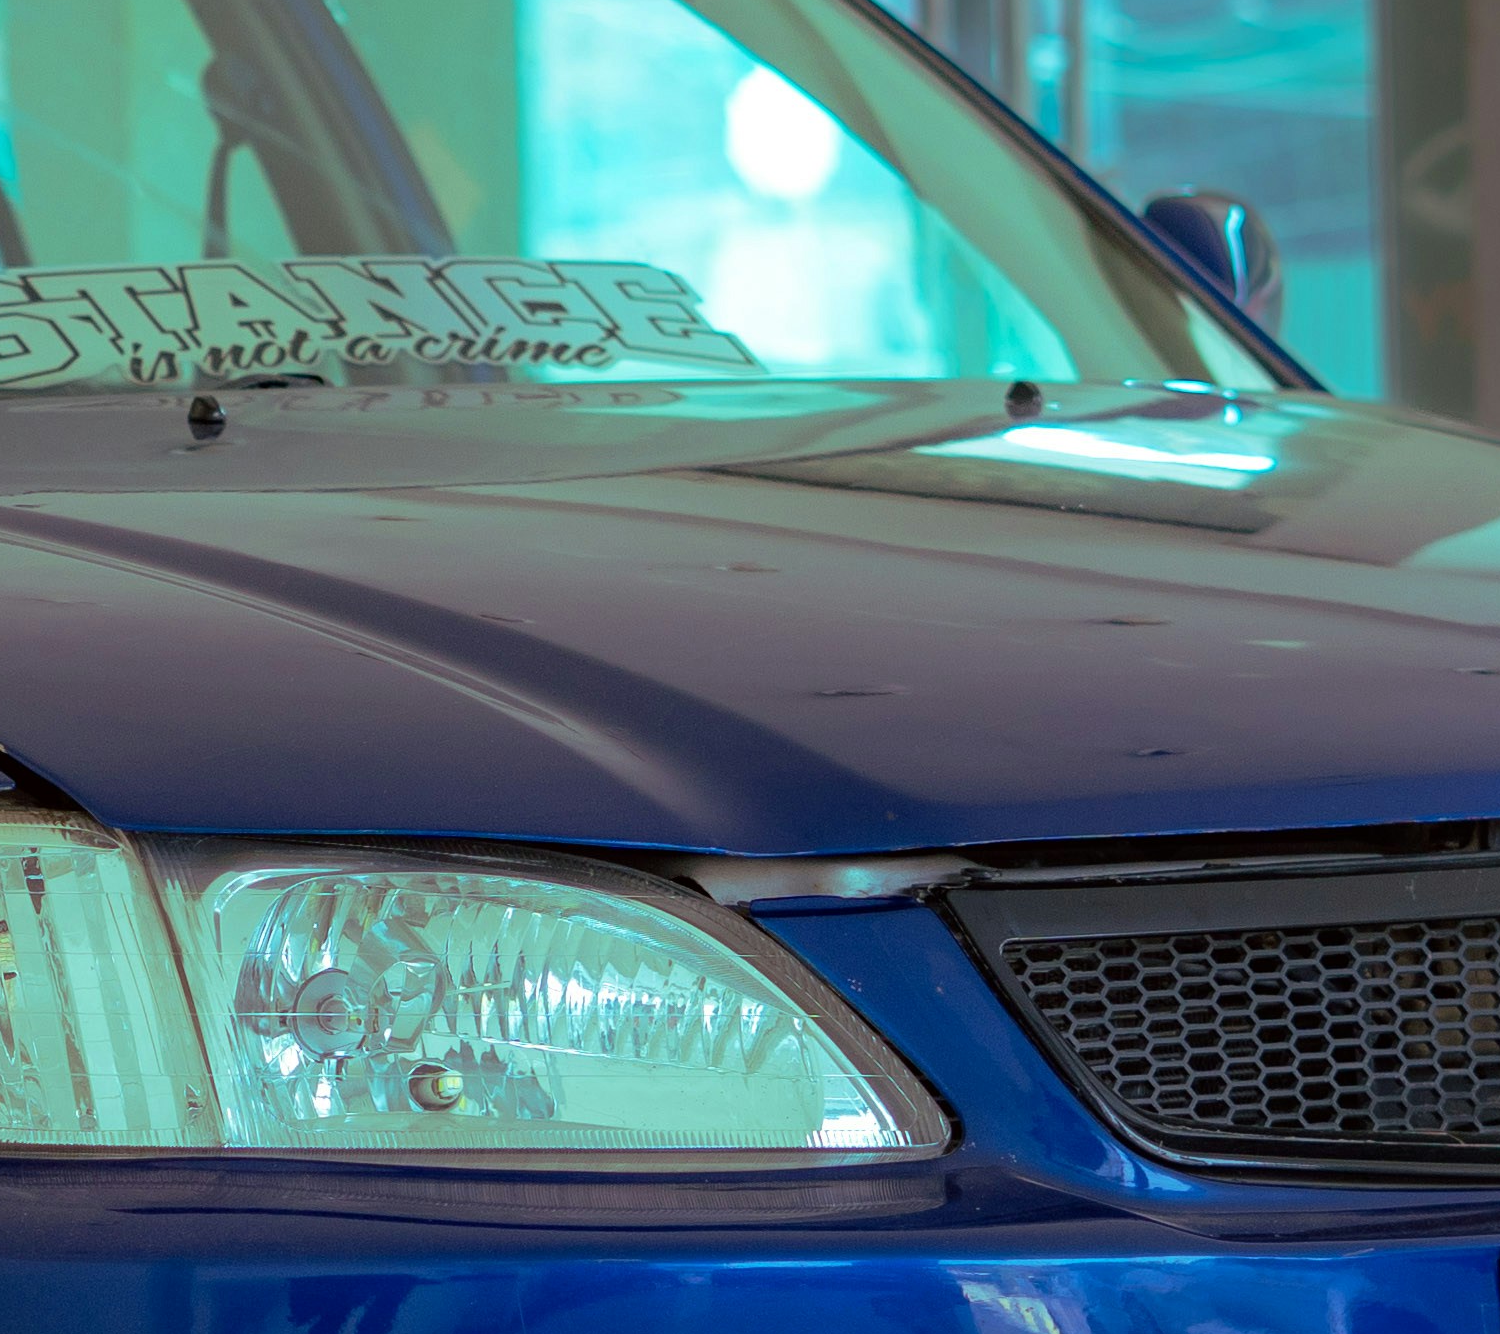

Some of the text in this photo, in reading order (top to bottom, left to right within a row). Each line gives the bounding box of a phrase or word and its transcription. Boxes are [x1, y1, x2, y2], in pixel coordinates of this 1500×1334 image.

[129, 326, 611, 384] is not a crime
